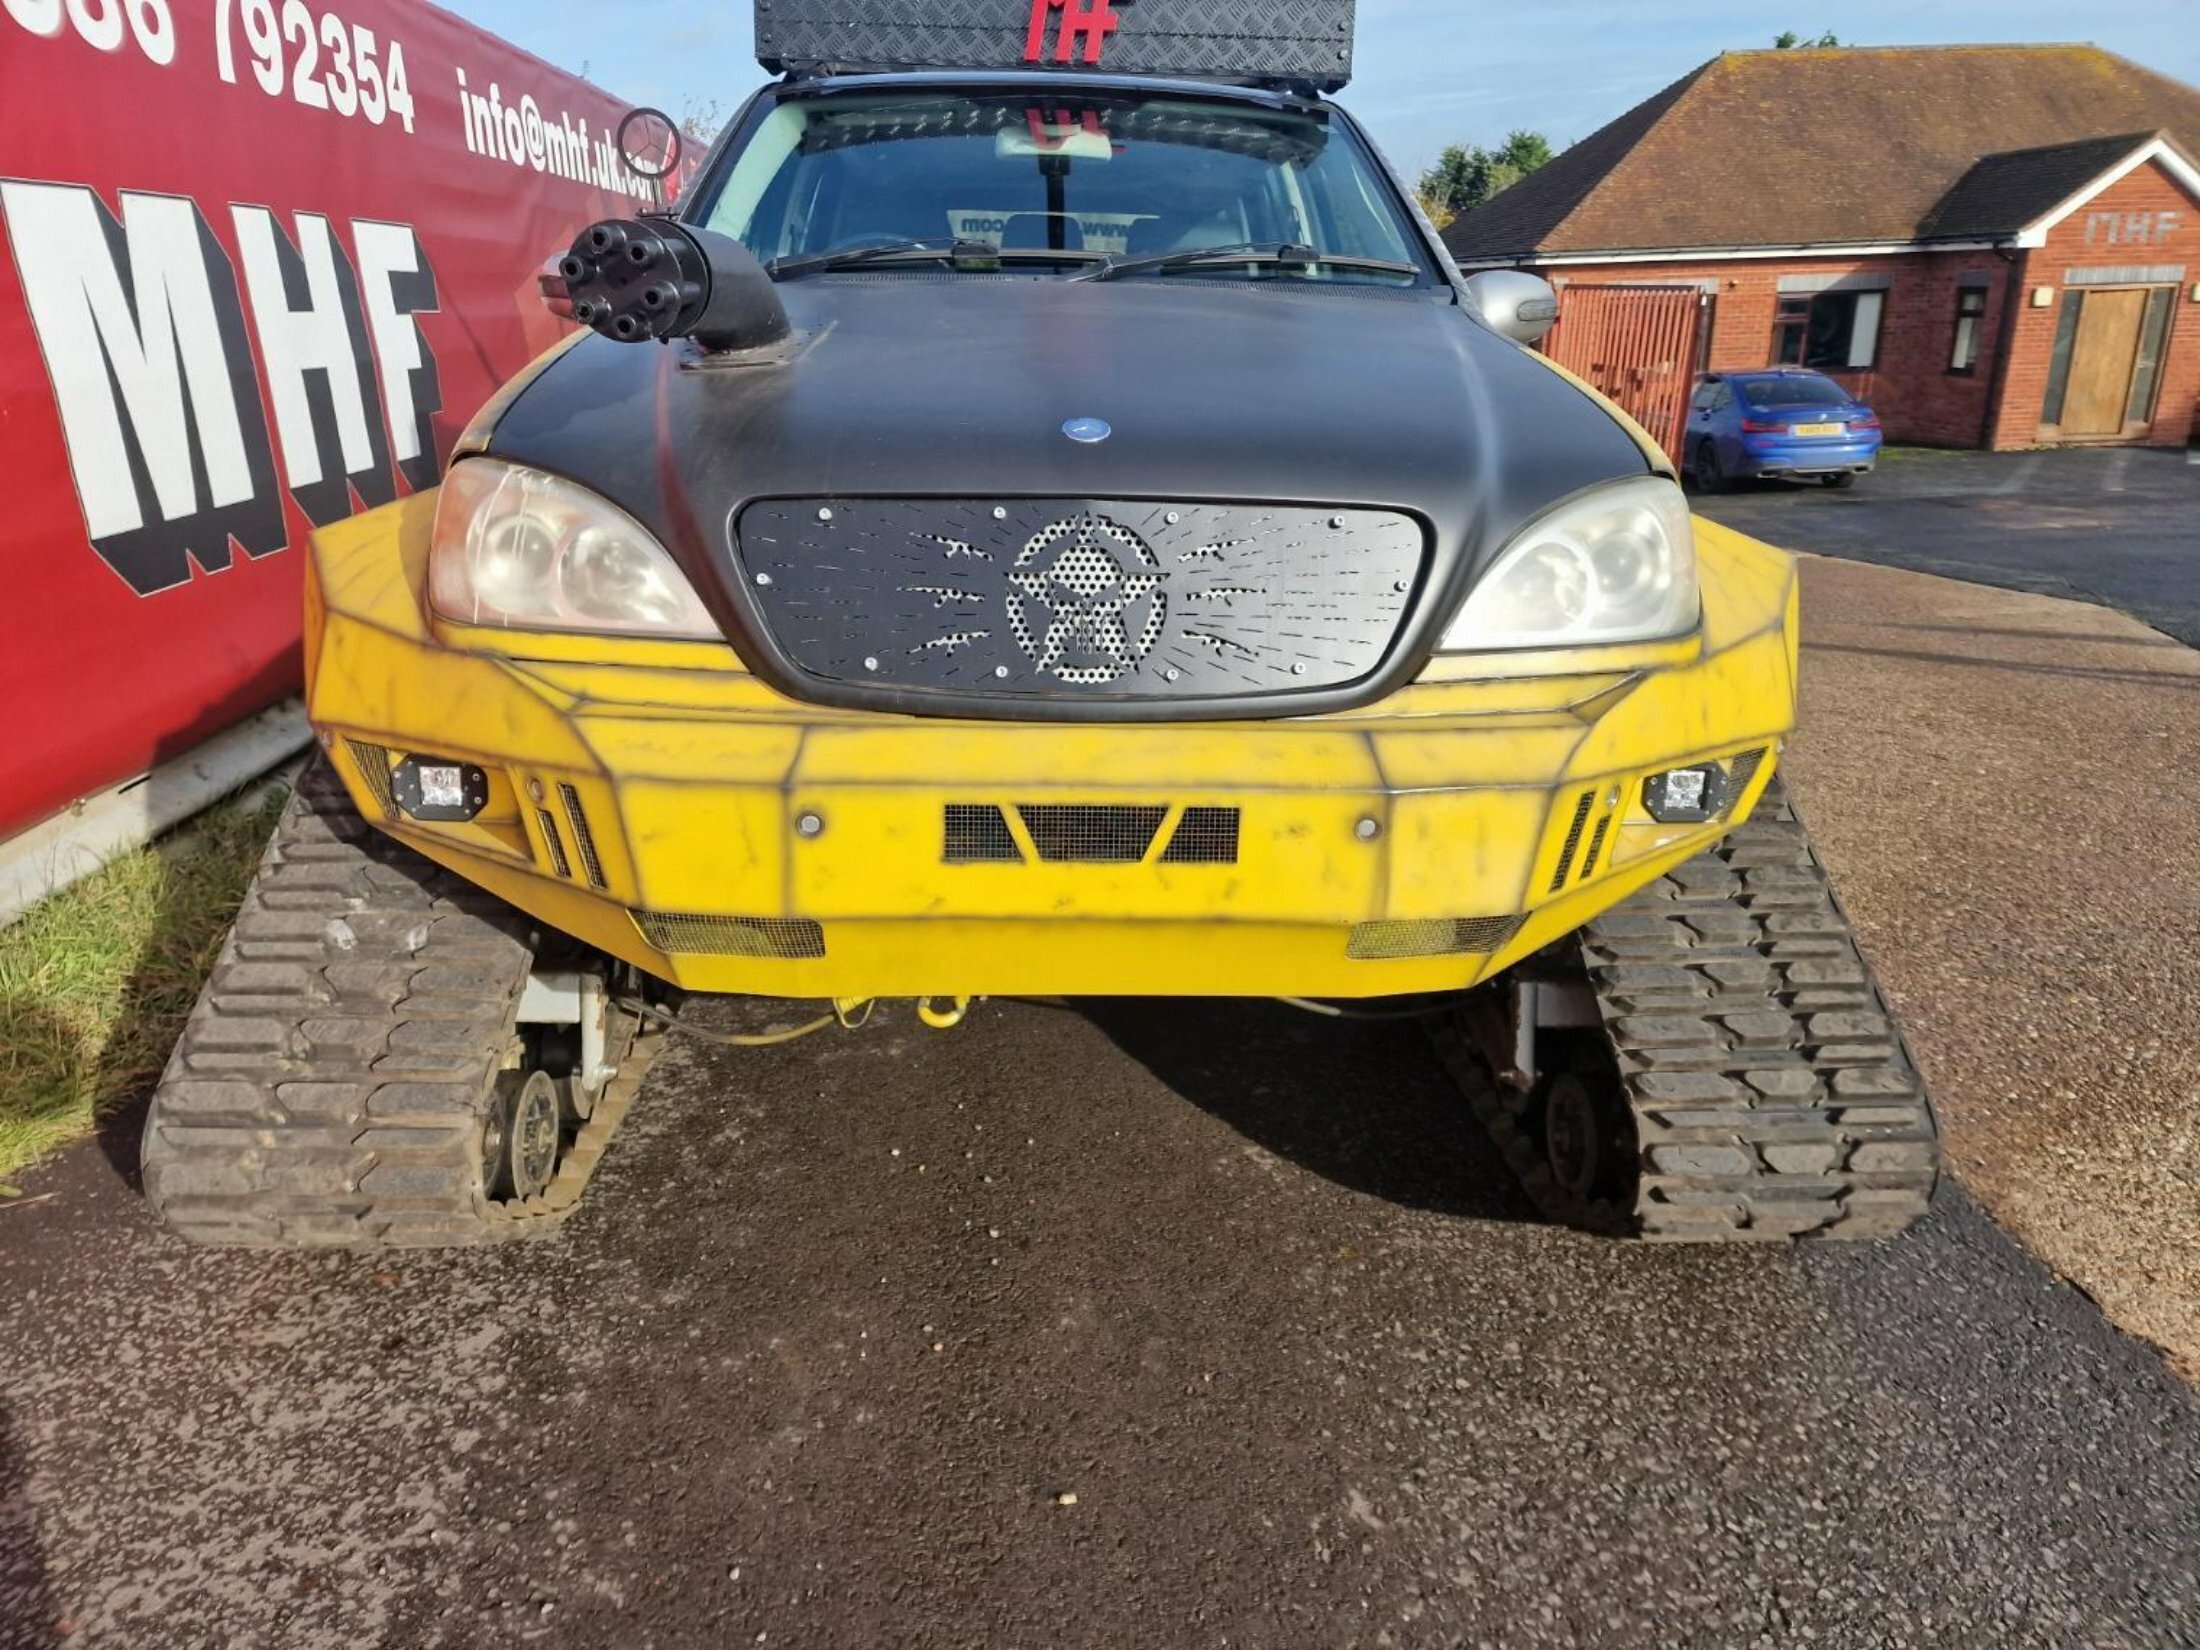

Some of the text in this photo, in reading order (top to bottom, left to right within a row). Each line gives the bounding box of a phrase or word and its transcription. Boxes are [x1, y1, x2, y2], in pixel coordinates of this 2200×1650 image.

[214, 0, 415, 134] 792354
[2084, 210, 2182, 245] MHF
[0, 178, 428, 552] MHF
